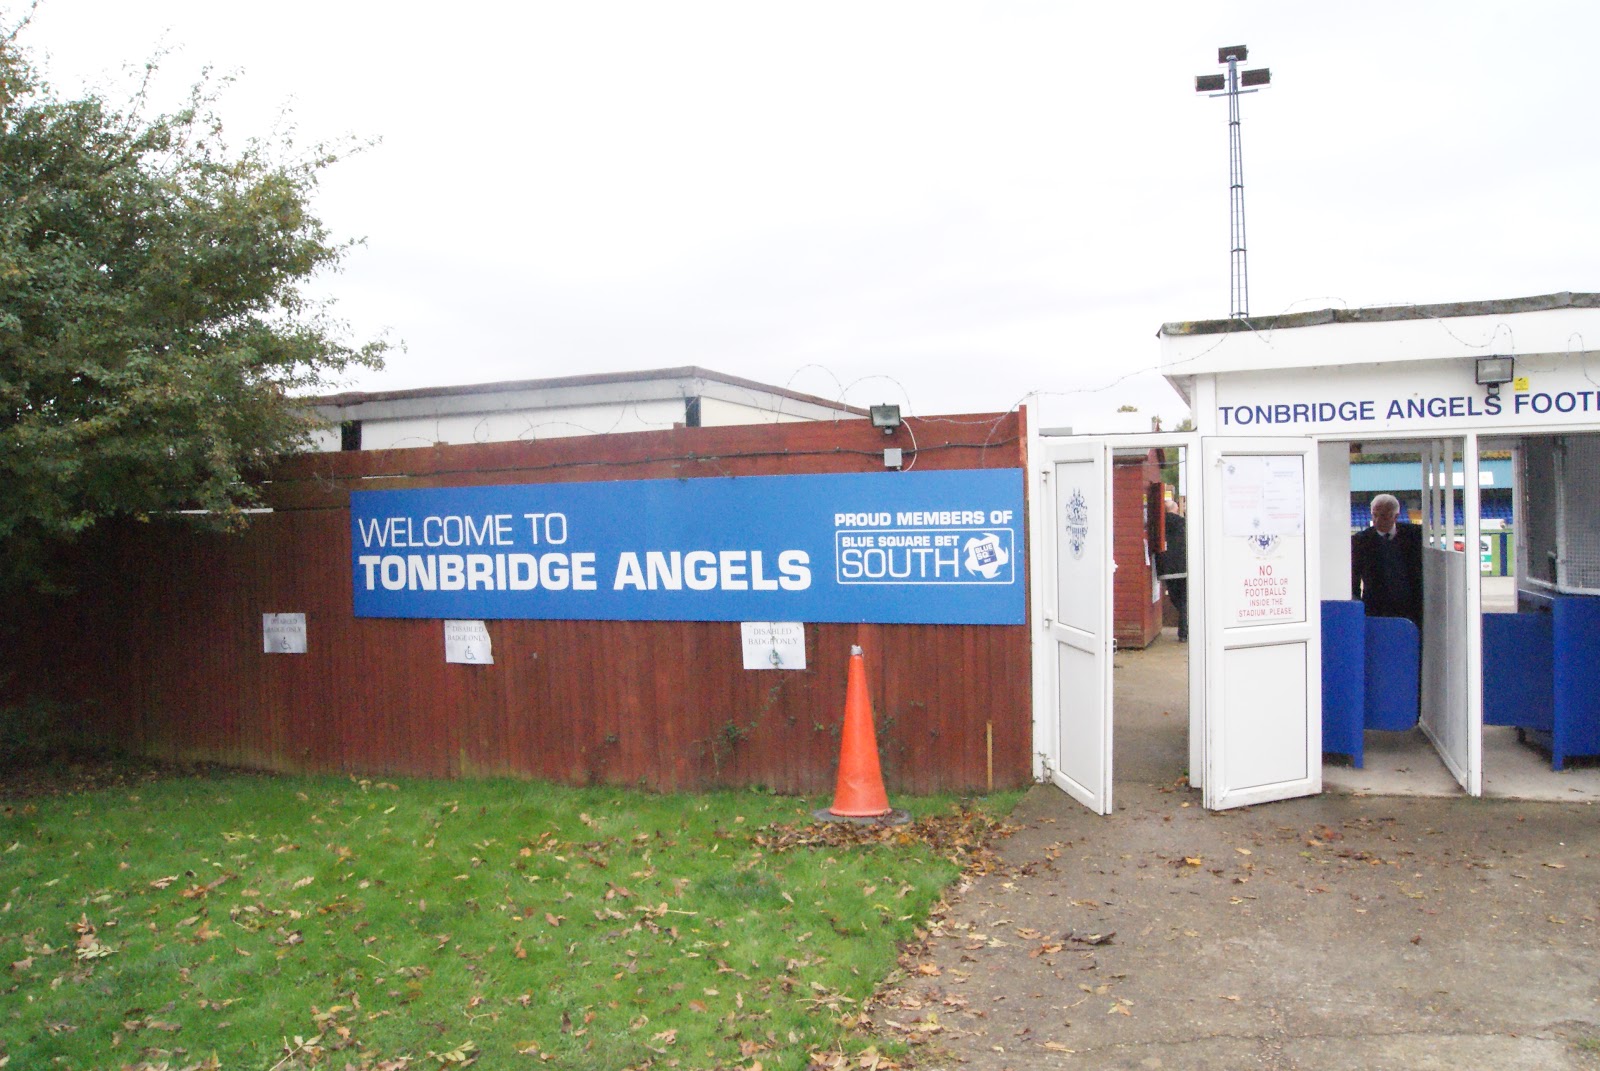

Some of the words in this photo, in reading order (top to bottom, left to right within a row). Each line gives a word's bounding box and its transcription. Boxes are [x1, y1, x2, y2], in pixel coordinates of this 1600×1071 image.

[1218, 401, 1375, 425] TONBRIDGE
[1386, 396, 1502, 419] ANGELS
[1515, 391, 1600, 415] FOOT
[834, 513, 891, 526] PROUD
[897, 511, 985, 526] MEMBERS
[990, 510, 1013, 524] OF
[358, 514, 513, 547] WELCOME
[524, 512, 567, 545] TO
[842, 537, 874, 547] BLUE
[878, 536, 930, 547] SQUARE
[935, 535, 960, 546] BET
[975, 543, 993, 554] BLUE
[842, 548, 959, 578] SOUTH
[359, 552, 597, 591] TONBRIDGE
[613, 550, 811, 591] ANGELS
[1259, 565, 1273, 576] NO
[1244, 578, 1278, 587] ALCOHOL
[1245, 587, 1287, 597] FOOTBALLS
